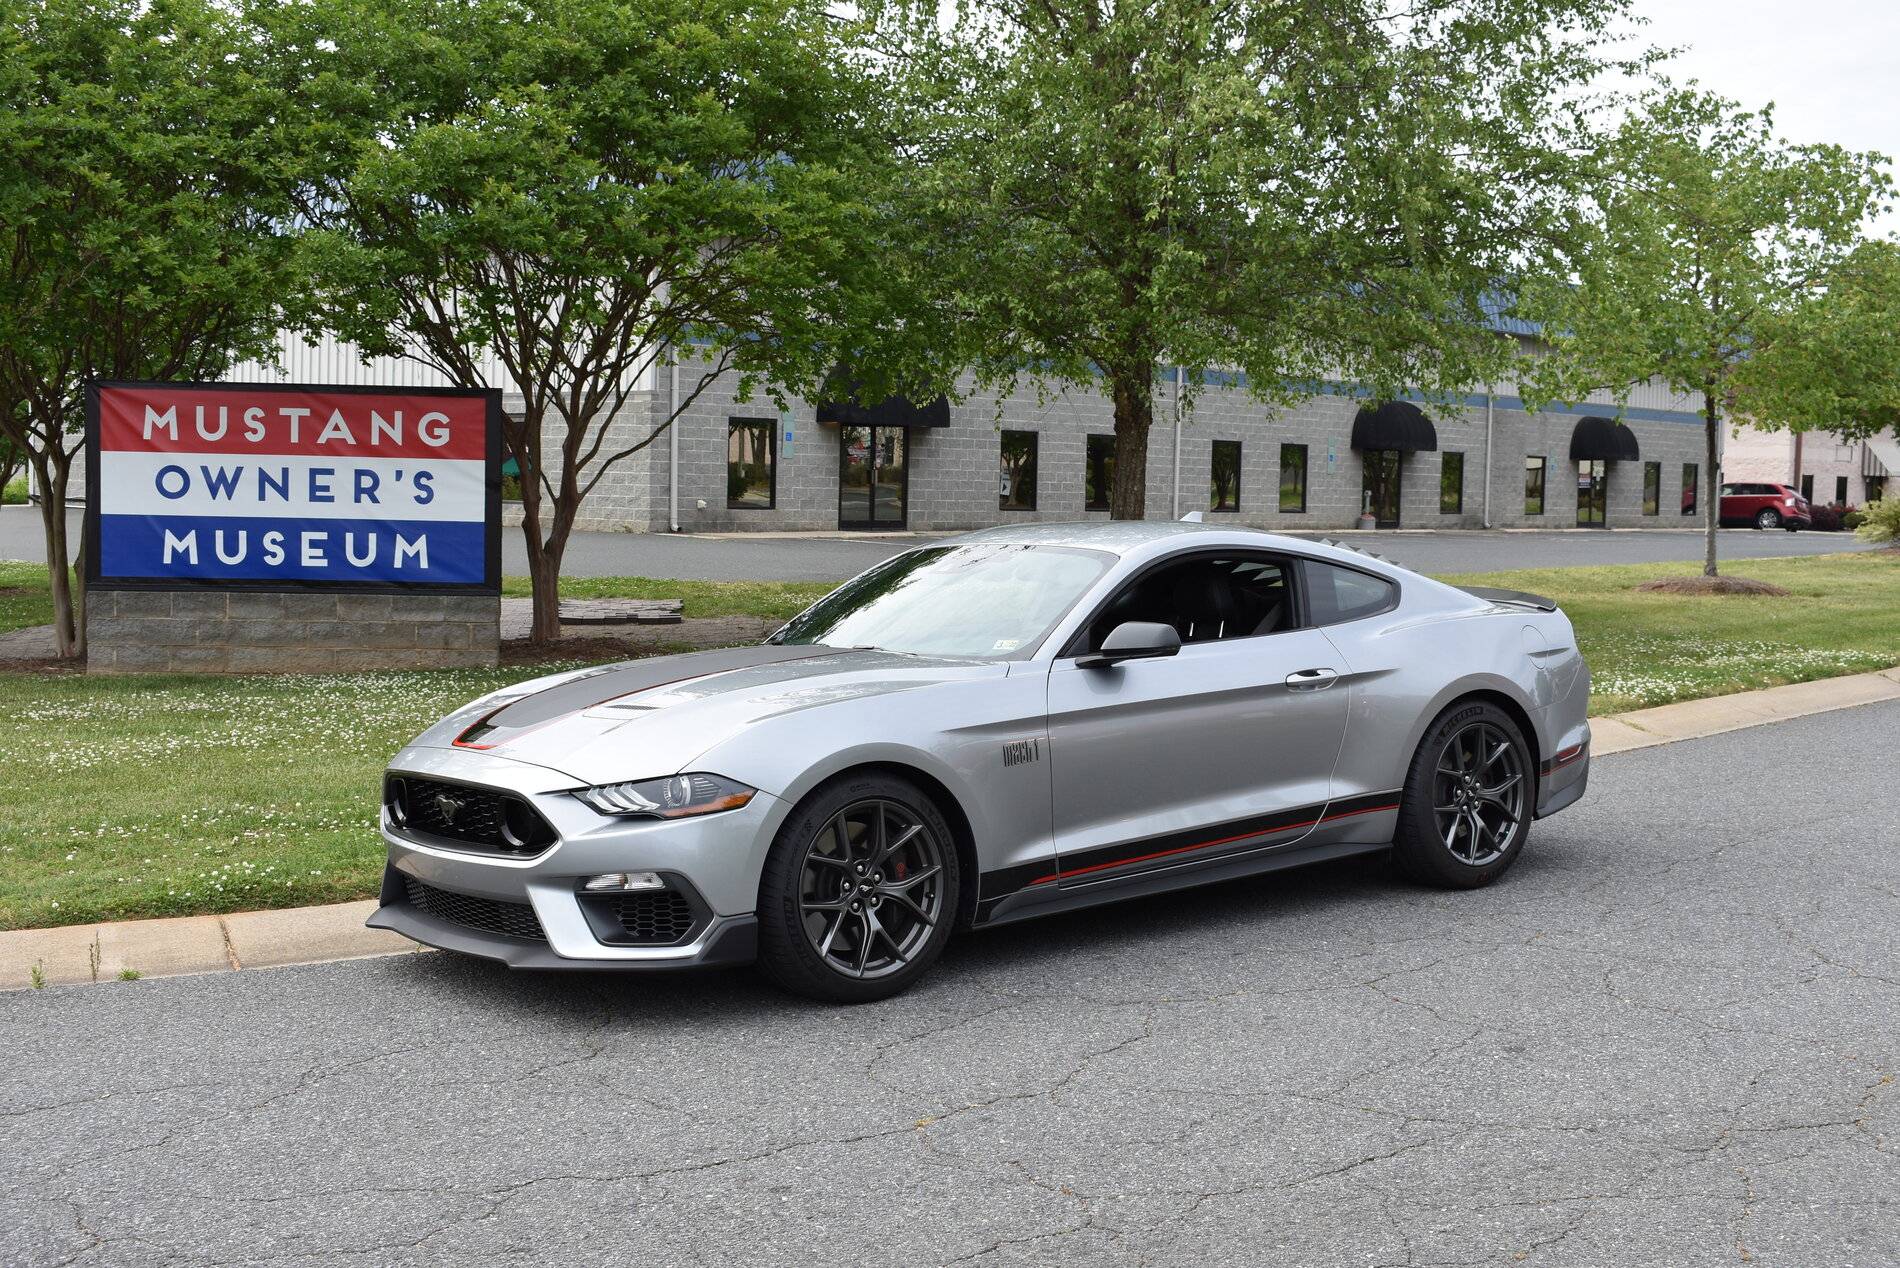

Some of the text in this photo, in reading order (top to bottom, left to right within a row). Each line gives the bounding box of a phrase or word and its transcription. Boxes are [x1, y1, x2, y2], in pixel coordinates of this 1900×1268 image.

[143, 405, 451, 447] MUSTANG
[155, 465, 435, 505] OWNER'S
[163, 529, 429, 569] MUSEUM
